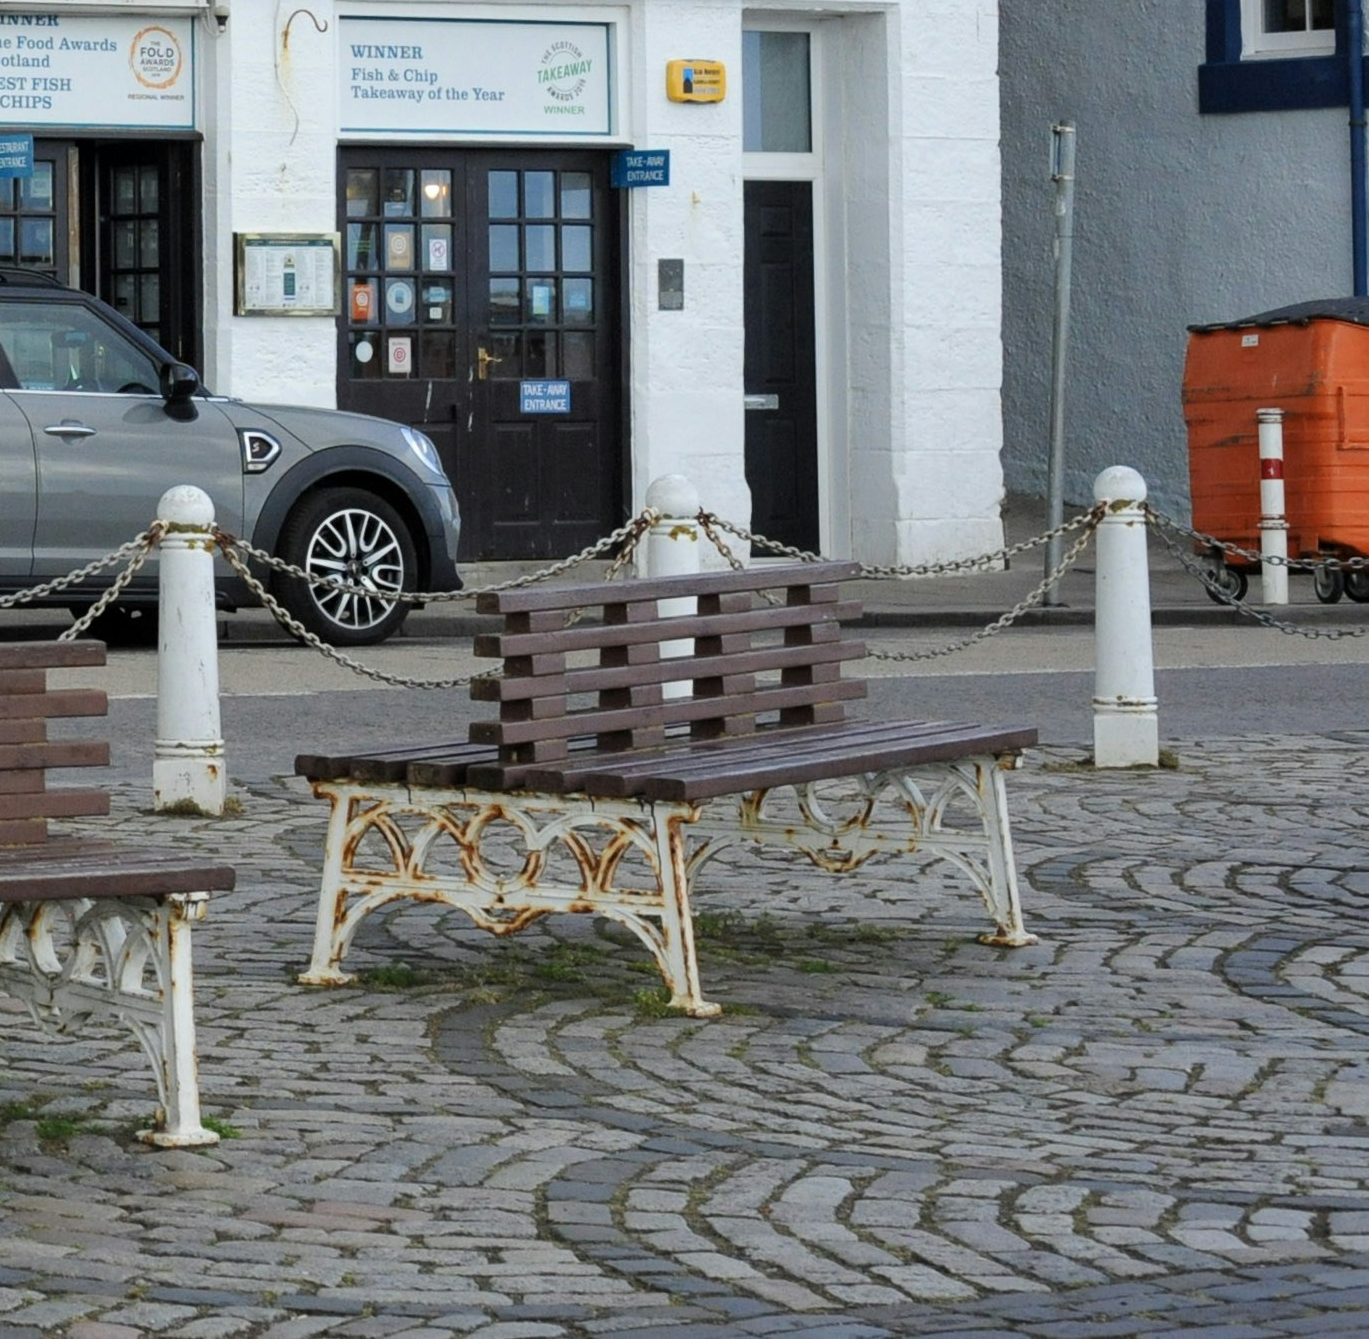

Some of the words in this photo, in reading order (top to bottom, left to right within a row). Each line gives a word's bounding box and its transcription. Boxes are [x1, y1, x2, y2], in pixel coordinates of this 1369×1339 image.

[16, 36, 54, 50] Food
[59, 37, 117, 52] Awards
[550, 40, 583, 59] SCOTTISH
[350, 45, 423, 60] WINNER
[140, 58, 175, 67] AWARDS
[351, 68, 384, 82] Fish
[387, 69, 400, 82] &
[403, 69, 438, 86] Chip
[537, 59, 593, 84] TAKEAWAY
[32, 77, 72, 92] FISH
[351, 86, 424, 103] Takeaway
[428, 87, 442, 101] of
[445, 87, 468, 101] the
[472, 88, 506, 102] Year
[546, 86, 574, 102] AWARDS
[0, 95, 52, 109] CHIPS
[543, 105, 586, 115] WINNER
[626, 156, 665, 167] TAKE-AWAY
[627, 170, 664, 181] ENTRANCE
[523, 384, 567, 395] TAKE-AWAY
[524, 399, 566, 410] ENTRANCE
[252, 442, 260, 452] S
